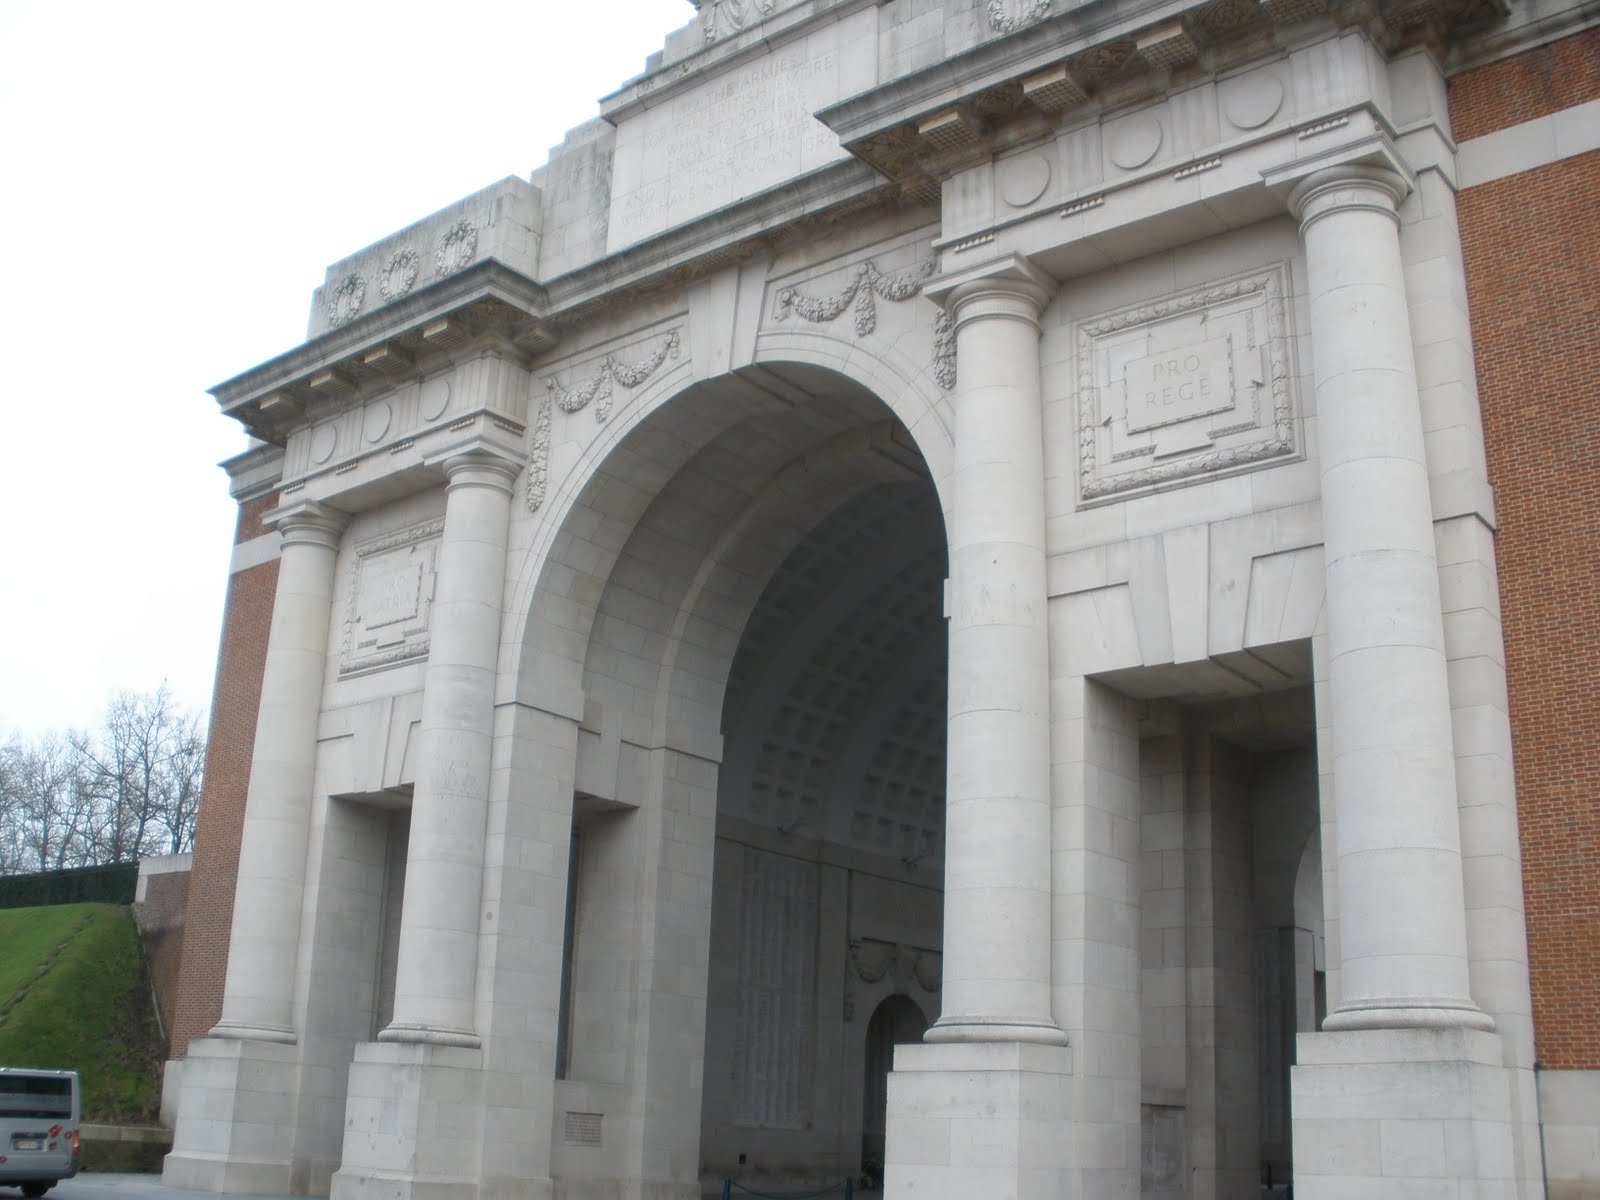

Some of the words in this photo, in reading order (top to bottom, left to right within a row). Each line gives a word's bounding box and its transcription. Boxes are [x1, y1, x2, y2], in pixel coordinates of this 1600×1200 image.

[707, 83, 733, 103] THE
[742, 57, 801, 88] ARMIES
[776, 55, 832, 88] EMPIRE
[760, 89, 807, 114] HERE
[753, 120, 773, 136] TO
[1153, 354, 1201, 382] PRO
[1145, 377, 1211, 408] REGE
